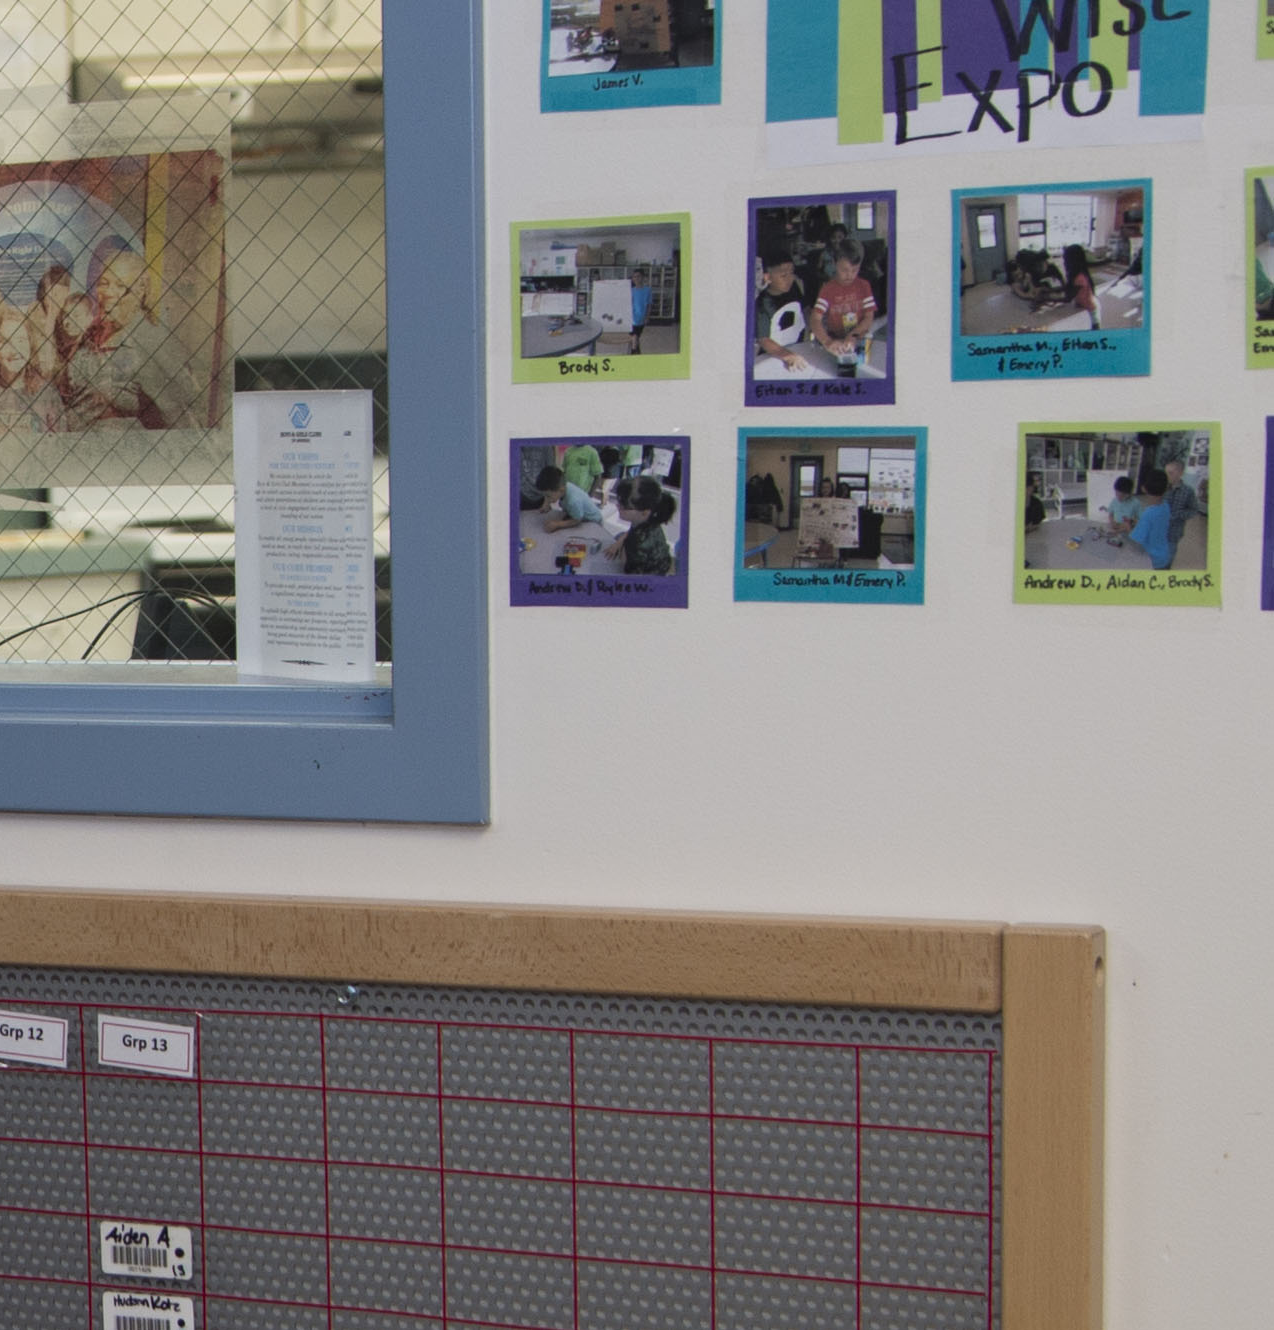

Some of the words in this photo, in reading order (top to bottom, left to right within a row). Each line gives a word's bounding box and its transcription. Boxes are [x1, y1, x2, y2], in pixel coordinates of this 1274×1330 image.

[592, 76, 629, 92] James
[631, 72, 644, 86] V.
[966, 341, 1033, 358] Samantha
[558, 359, 598, 376] Brody
[601, 358, 615, 372] S.
[1009, 356, 1049, 374] Emery
[1051, 354, 1064, 369] P.
[528, 579, 573, 596] Andrew
[772, 571, 830, 587] Samantha
[853, 572, 894, 589] Emery
[895, 571, 907, 586] P.
[1024, 574, 1076, 590] Andrew
[1167, 575, 1204, 592] Brody
[0, 1023, 24, 1041] Grp
[28, 1027, 44, 1041] 12
[122, 1033, 147, 1051] Grp
[152, 1038, 168, 1052] 13
[105, 1223, 150, 1249] Aiden
[157, 1224, 170, 1249] A
